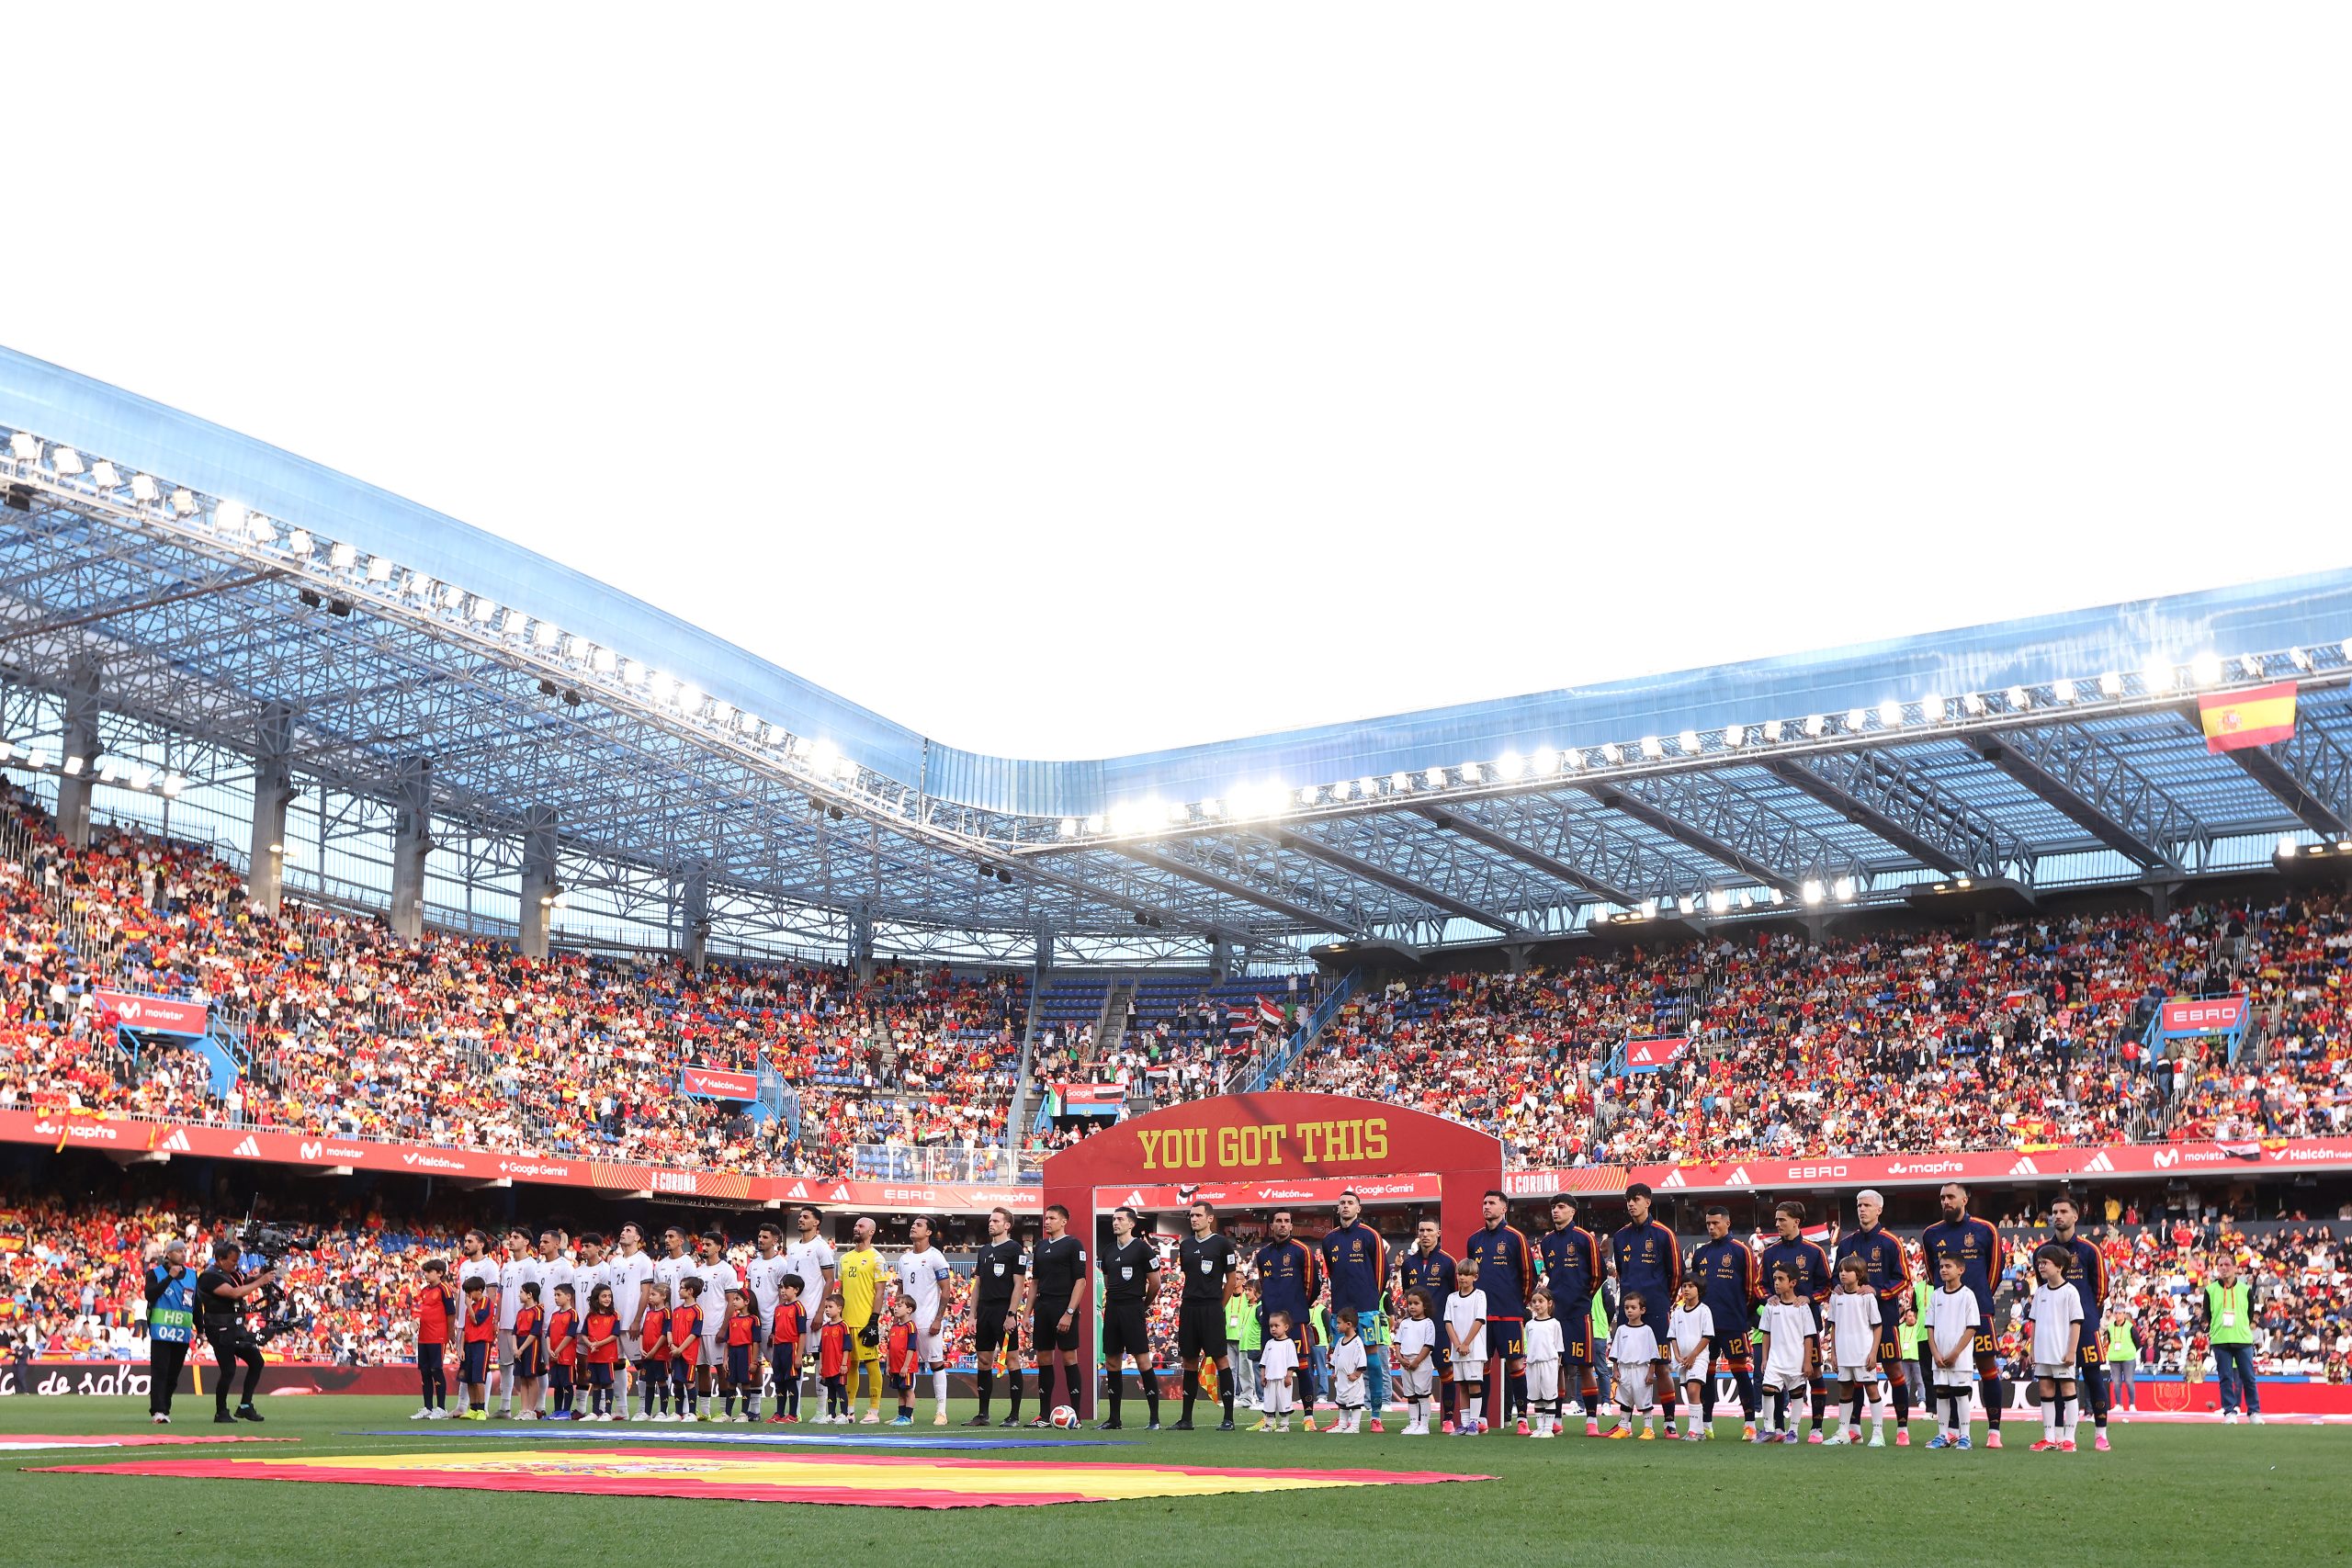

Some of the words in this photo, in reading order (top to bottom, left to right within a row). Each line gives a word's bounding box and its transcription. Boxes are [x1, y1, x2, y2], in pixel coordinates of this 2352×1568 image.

[145, 1009, 184, 1021] movistar
[707, 1078, 734, 1090] Halcón
[1066, 1089, 1091, 1098] Google
[1137, 1128, 1208, 1169] YOU
[1218, 1124, 1286, 1167] GOT
[1295, 1118, 1387, 1164] THIS
[327, 1148, 364, 1158] movistar
[2185, 1151, 2229, 1161] movista
[2290, 1147, 2334, 1160] Halcón
[419, 1156, 449, 1168] Halcón
[509, 1161, 538, 1176] Google
[540, 1164, 568, 1177] Gemini
[1909, 1161, 1963, 1176] mapfre
[651, 1172, 658, 1189] A
[660, 1172, 696, 1192] CORUÑA
[1506, 1176, 1512, 1193] A
[1516, 1172, 1558, 1193] CORUÑA
[1272, 1189, 1299, 1199] Halcón
[1355, 1185, 1382, 1196] Google
[1385, 1183, 1414, 1193] Gemini
[989, 1191, 1035, 1203] mapfre
[616, 1273, 625, 1285] 24
[849, 1267, 856, 1278] 22
[755, 1277, 761, 1288] 3
[164, 1311, 184, 1324] HB
[159, 1326, 185, 1341] 042
[1363, 1327, 1374, 1342] 13
[1295, 1340, 1301, 1354] 7
[1508, 1339, 1521, 1354] 14
[1572, 1342, 1584, 1358] 16
[1729, 1338, 1744, 1355] 12
[1975, 1335, 1993, 1352] 26
[1442, 1348, 1450, 1362] 3
[1658, 1345, 1668, 1359] 18
[1881, 1343, 1894, 1359] 10
[2082, 1346, 2098, 1363] 15
[38, 1371, 71, 1395] de
